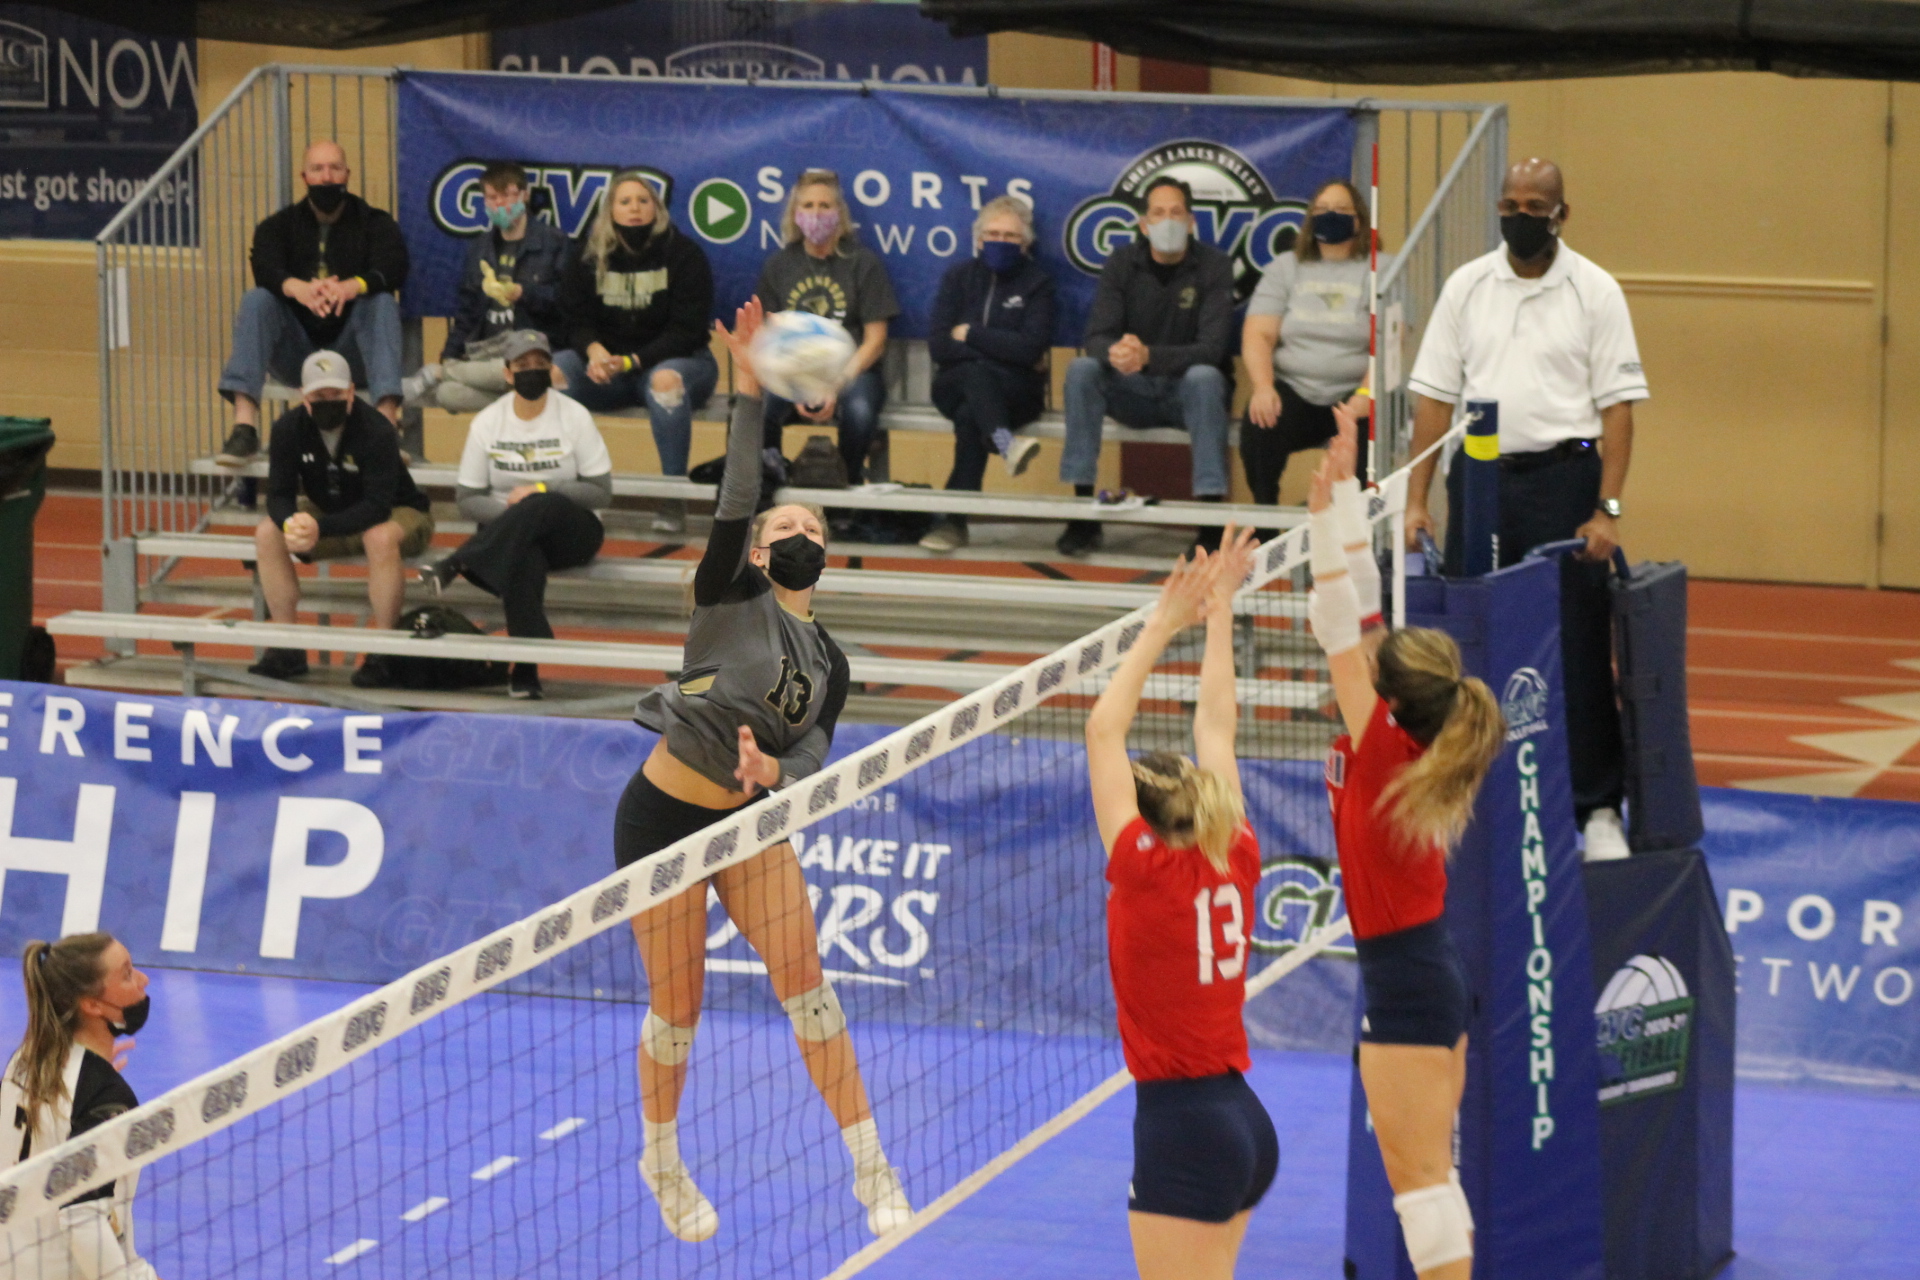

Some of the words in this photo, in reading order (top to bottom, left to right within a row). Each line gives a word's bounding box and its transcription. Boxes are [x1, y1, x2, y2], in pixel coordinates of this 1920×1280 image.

[58, 37, 198, 110] NOW
[34, 172, 79, 211] got
[757, 166, 1035, 213] SORTS
[1122, 153, 1164, 192] GREAT
[1166, 147, 1214, 162] LAKES
[1217, 153, 1263, 195] VALLEY
[764, 656, 814, 727] 13
[0, 776, 385, 960] HIP
[902, 842, 951, 880] IT
[1193, 883, 1248, 985] 13
[1516, 742, 1554, 1150] CHAMPIONSHIP
